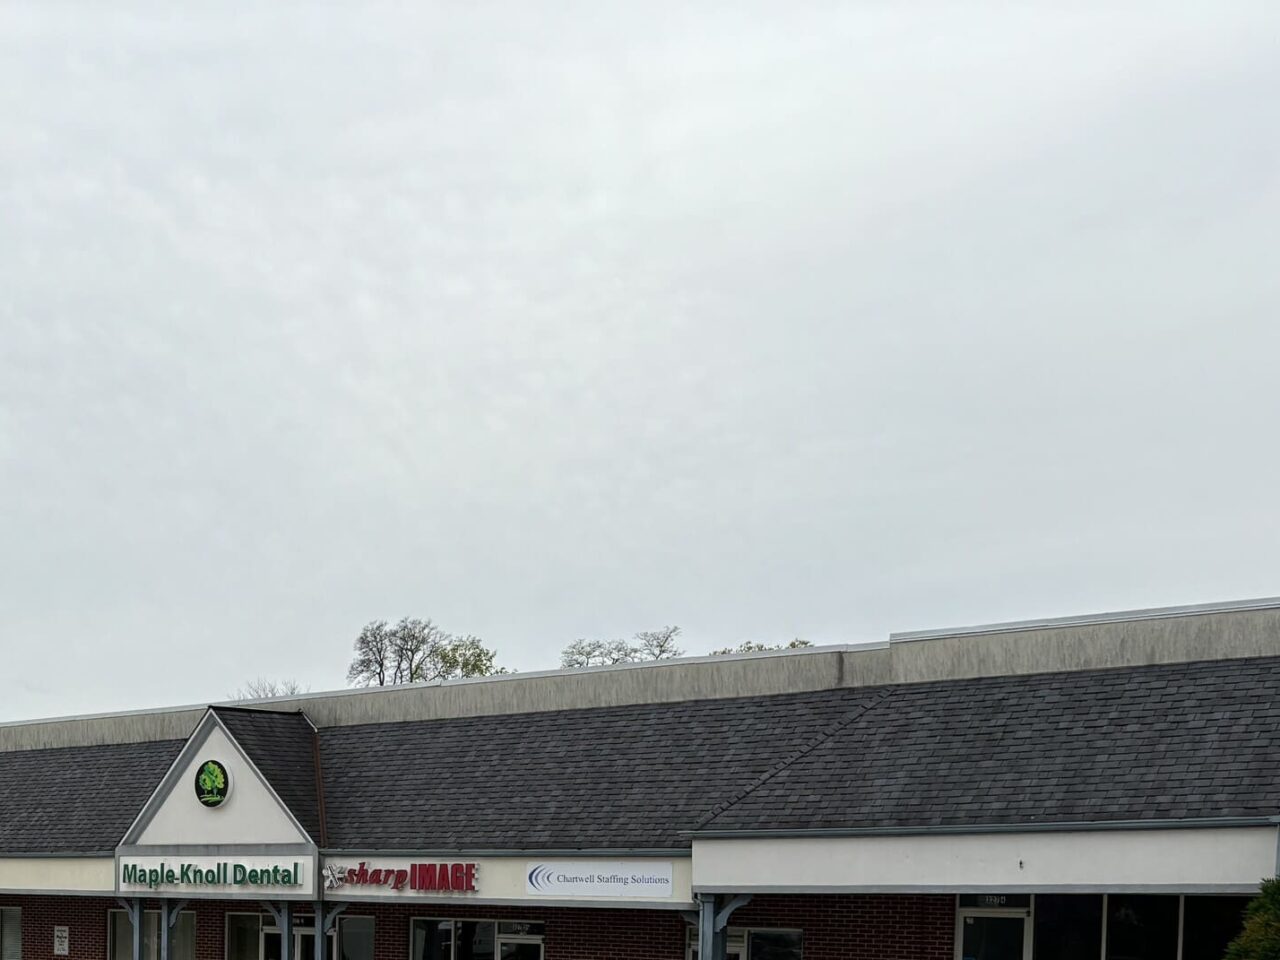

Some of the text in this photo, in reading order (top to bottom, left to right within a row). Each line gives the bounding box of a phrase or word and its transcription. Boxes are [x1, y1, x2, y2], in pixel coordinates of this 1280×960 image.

[122, 862, 298, 889] Maple Knoll Dental
[345, 861, 476, 891] sharp IMAGE
[556, 874, 670, 886] Chartwell Staffing Solutions
